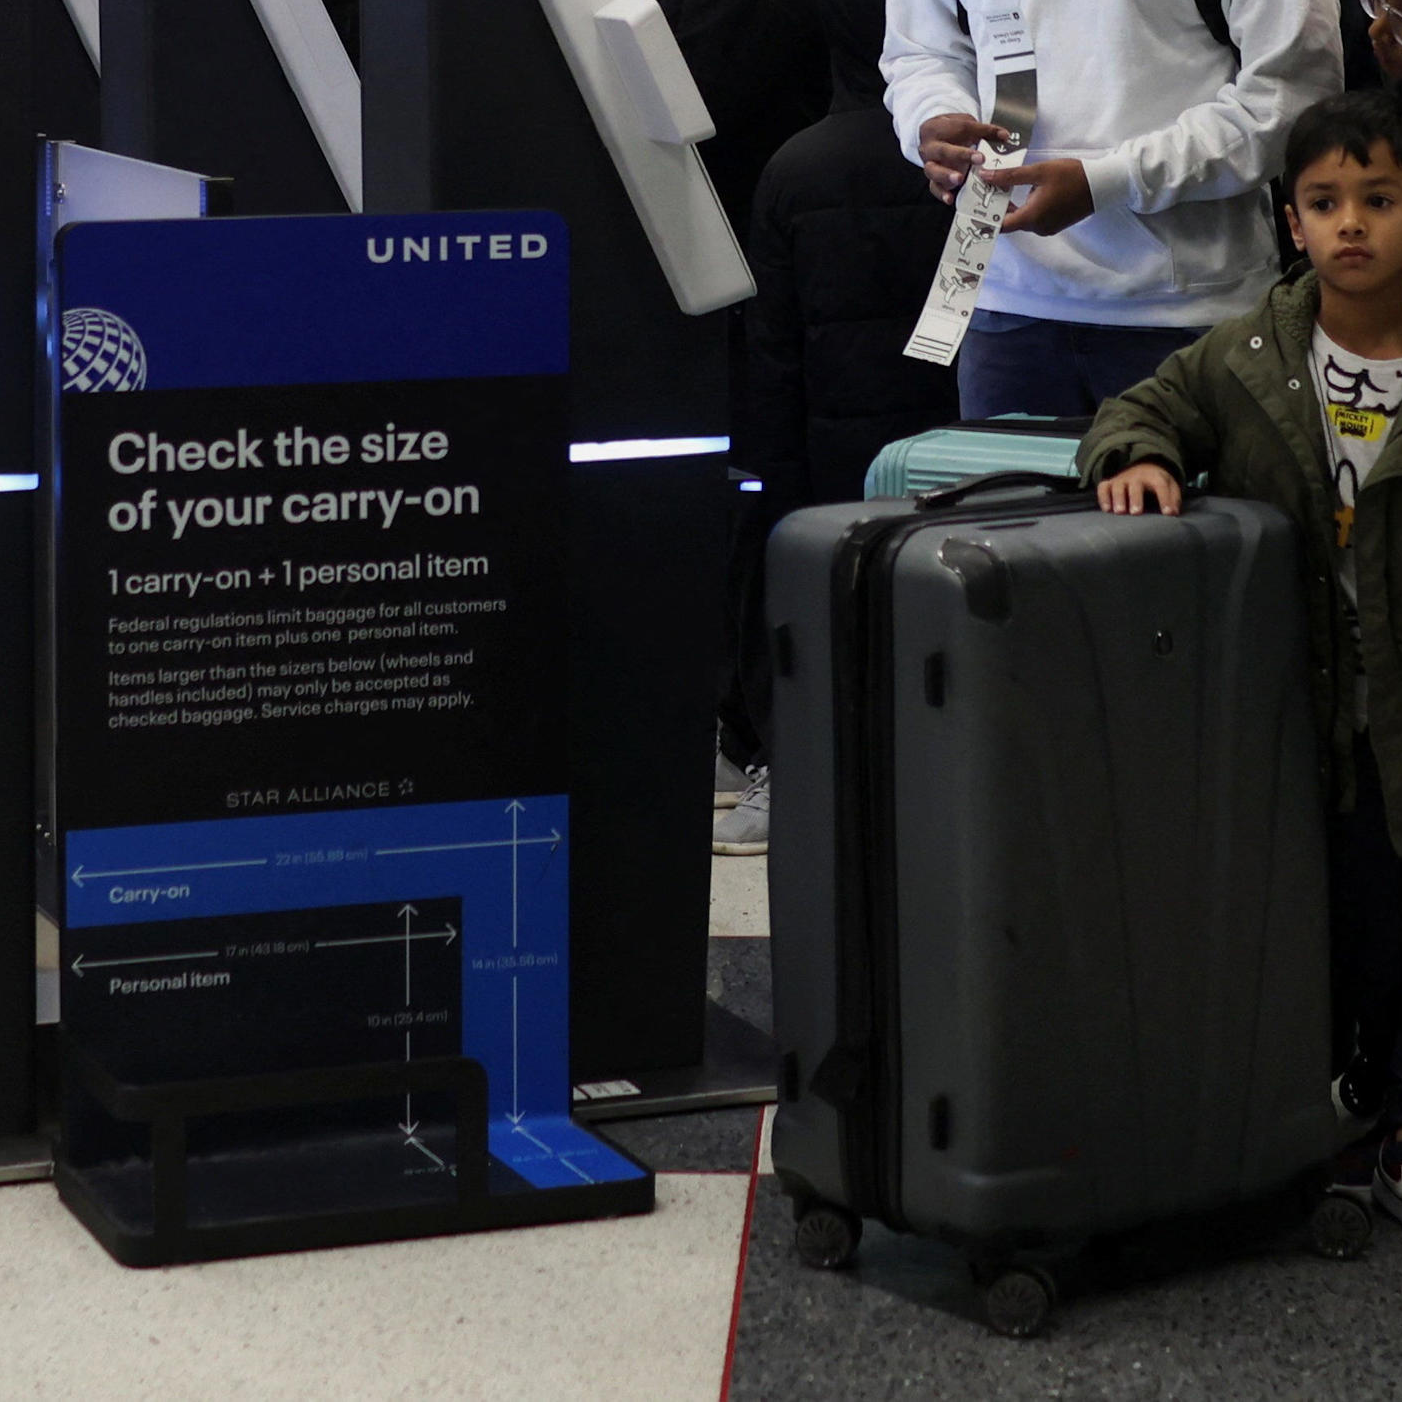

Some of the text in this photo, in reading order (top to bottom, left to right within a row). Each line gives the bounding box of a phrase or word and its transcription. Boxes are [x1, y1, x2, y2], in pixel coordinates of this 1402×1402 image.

[366, 234, 548, 264] UNITED
[1338, 409, 1369, 424] MICKEY
[1339, 420, 1369, 434] MOUSE
[108, 422, 450, 475] Check the size
[108, 484, 481, 541] of your carry-on
[108, 553, 489, 598] 1 carry-on + 1 personal item
[109, 599, 507, 634] Federal regulations limit baggage for all customers
[108, 621, 459, 655] to one carry-on item plus one personal item.
[109, 649, 474, 686] Items larger than the sizers below (wheels and
[108, 673, 452, 708] handles included) may only be accepted as
[108, 690, 475, 729] checked baggage. Service charges may apply.
[226, 780, 391, 808] STAR ALLIANCE
[275, 853, 290, 866] 22
[346, 847, 369, 863] cm)
[109, 883, 190, 904] Carry-on
[225, 945, 237, 958] 17
[238, 944, 249, 957] in
[287, 939, 310, 954] cm)
[471, 958, 483, 970] 14
[485, 957, 496, 970] in
[536, 951, 558, 966] cm)
[109, 970, 231, 995] Personal item
[367, 1014, 380, 1028] 10
[382, 1013, 392, 1026] in
[425, 1009, 449, 1023] cm)
